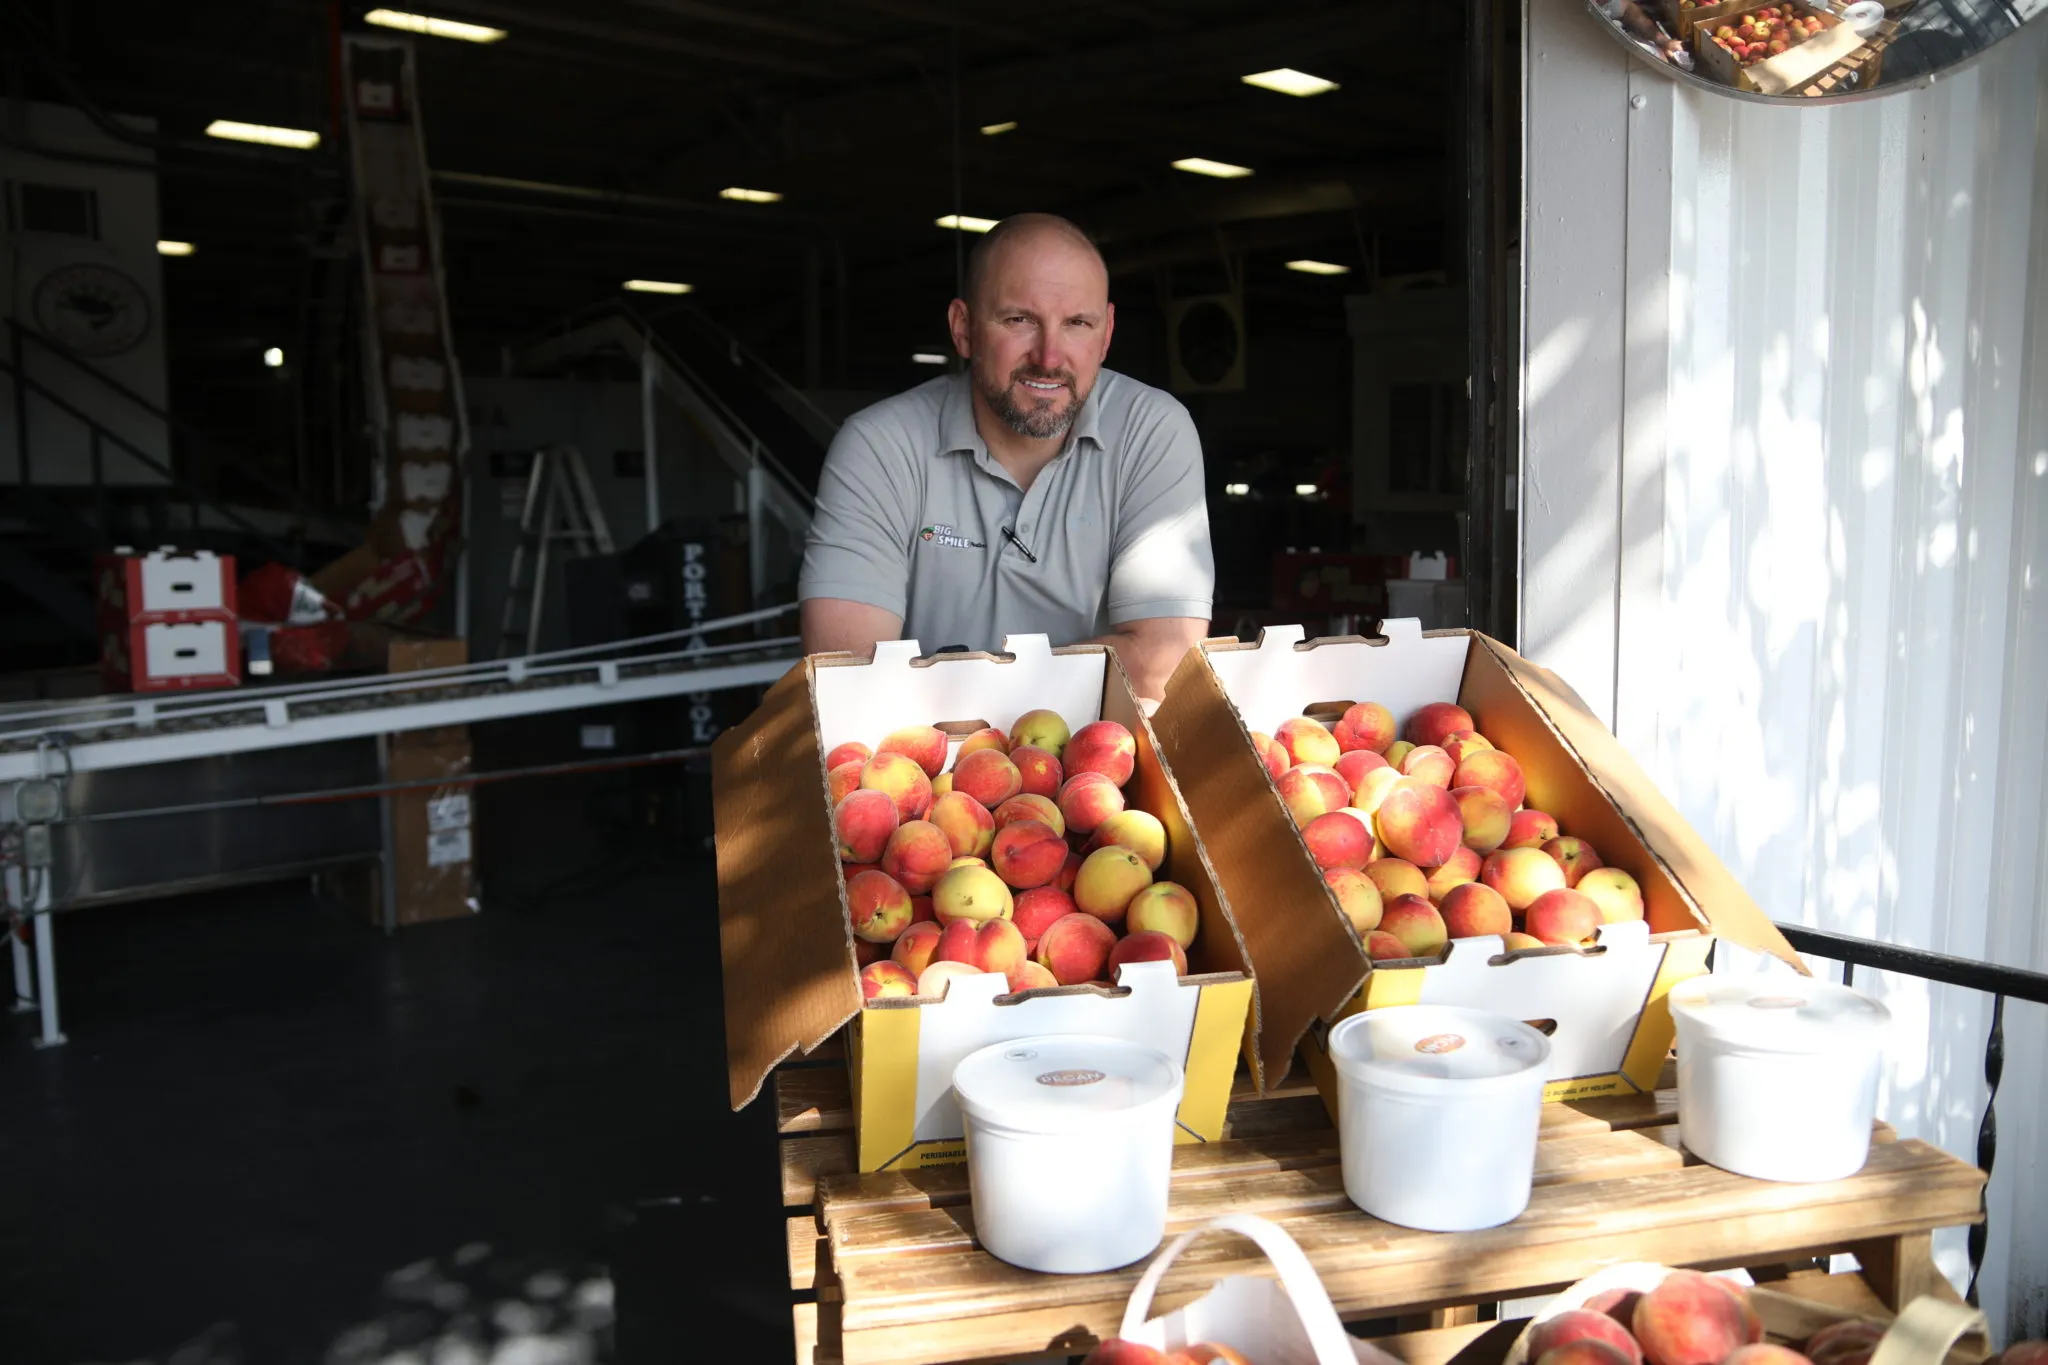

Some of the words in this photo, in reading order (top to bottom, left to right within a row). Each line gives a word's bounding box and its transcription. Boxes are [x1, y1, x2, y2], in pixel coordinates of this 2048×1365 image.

[933, 525, 951, 536] BIG
[937, 536, 969, 548] SMILE
[1040, 1071, 1100, 1083] PECAN
